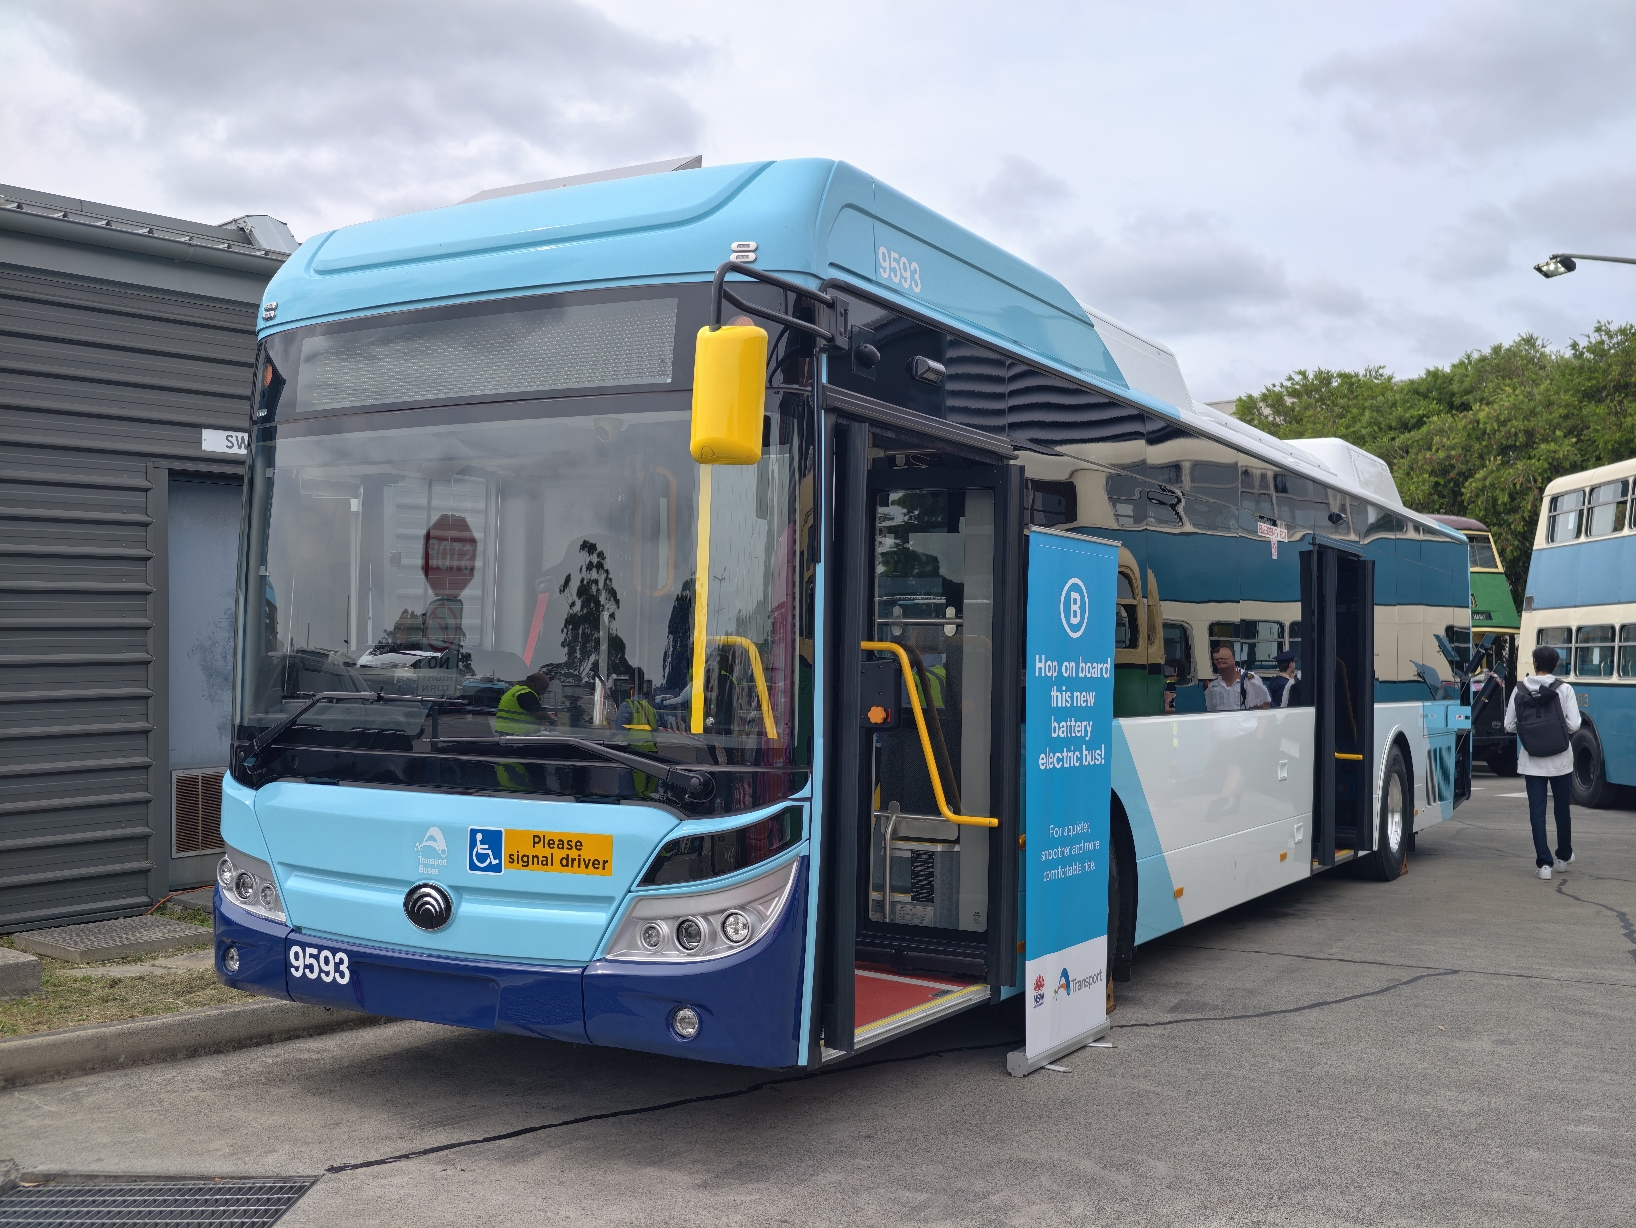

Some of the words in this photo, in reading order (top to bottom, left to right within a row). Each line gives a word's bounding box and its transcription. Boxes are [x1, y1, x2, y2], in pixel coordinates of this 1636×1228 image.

[878, 245, 922, 293] 9593
[225, 434, 248, 451] SW
[1069, 591, 1081, 625] B
[1035, 654, 1058, 681] Hop
[1061, 659, 1076, 678] on
[1079, 656, 1111, 678] board
[1051, 685, 1071, 708] this
[1073, 690, 1095, 707] new
[1577, 693, 1589, 707] 03
[1051, 715, 1092, 740] battery
[1038, 746, 1080, 770] electric
[1082, 744, 1105, 766] bus!
[1049, 824, 1062, 838] For
[532, 834, 583, 851] Please
[1041, 845, 1070, 861] smoother
[1071, 840, 1084, 855] and
[1085, 840, 1100, 852] more
[418, 856, 448, 866] Transport
[418, 866, 439, 875] Buses
[508, 852, 554, 868] signal
[559, 853, 609, 871] driver
[1043, 861, 1082, 882] comfortable
[289, 945, 351, 985] 9593
[1071, 968, 1103, 994] Transport
